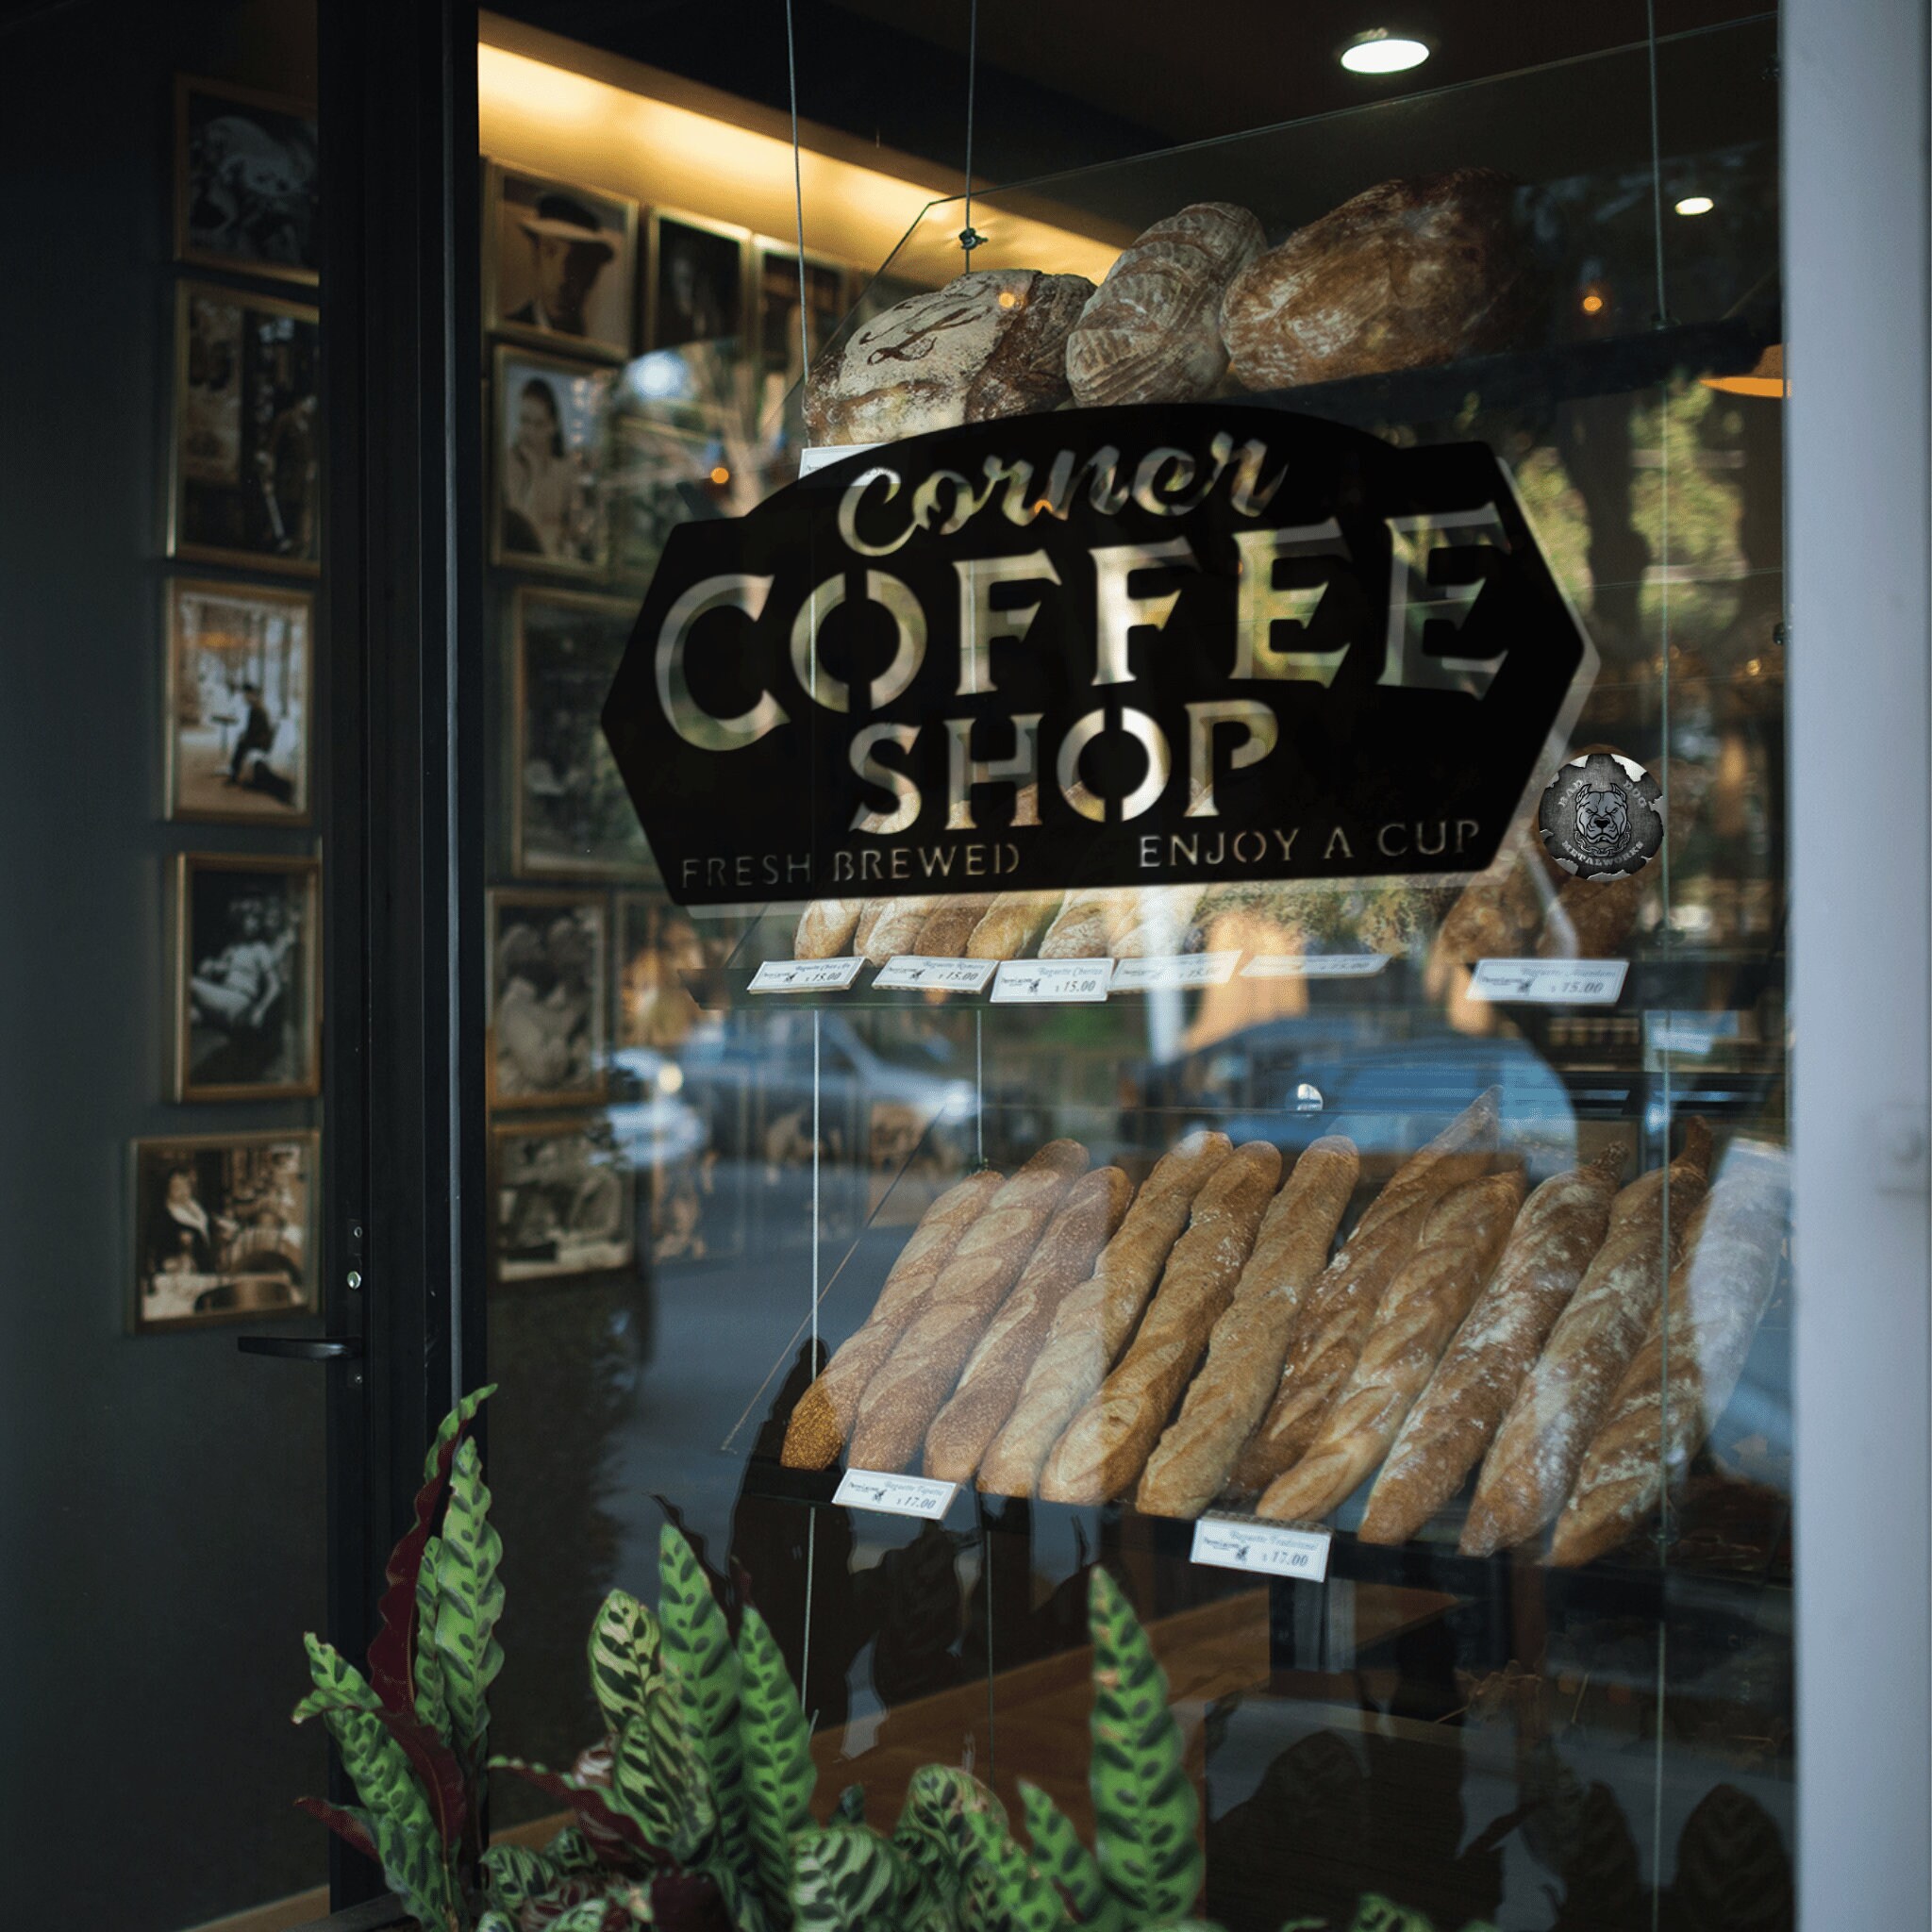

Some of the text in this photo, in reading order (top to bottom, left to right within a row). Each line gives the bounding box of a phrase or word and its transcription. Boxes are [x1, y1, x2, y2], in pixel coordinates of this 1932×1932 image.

[838, 431, 1288, 557] Corner
[655, 503, 1512, 751] COFFEE
[849, 699, 1279, 835] SHOP
[681, 843, 1021, 889] FRESH BREWED
[1140, 820, 1481, 867] ENJOY A CUP
[945, 971, 978, 981] 15.00
[1063, 980, 1096, 992] 15.00
[904, 1496, 937, 1509] 17.00
[1272, 1551, 1309, 1567] 17.00
